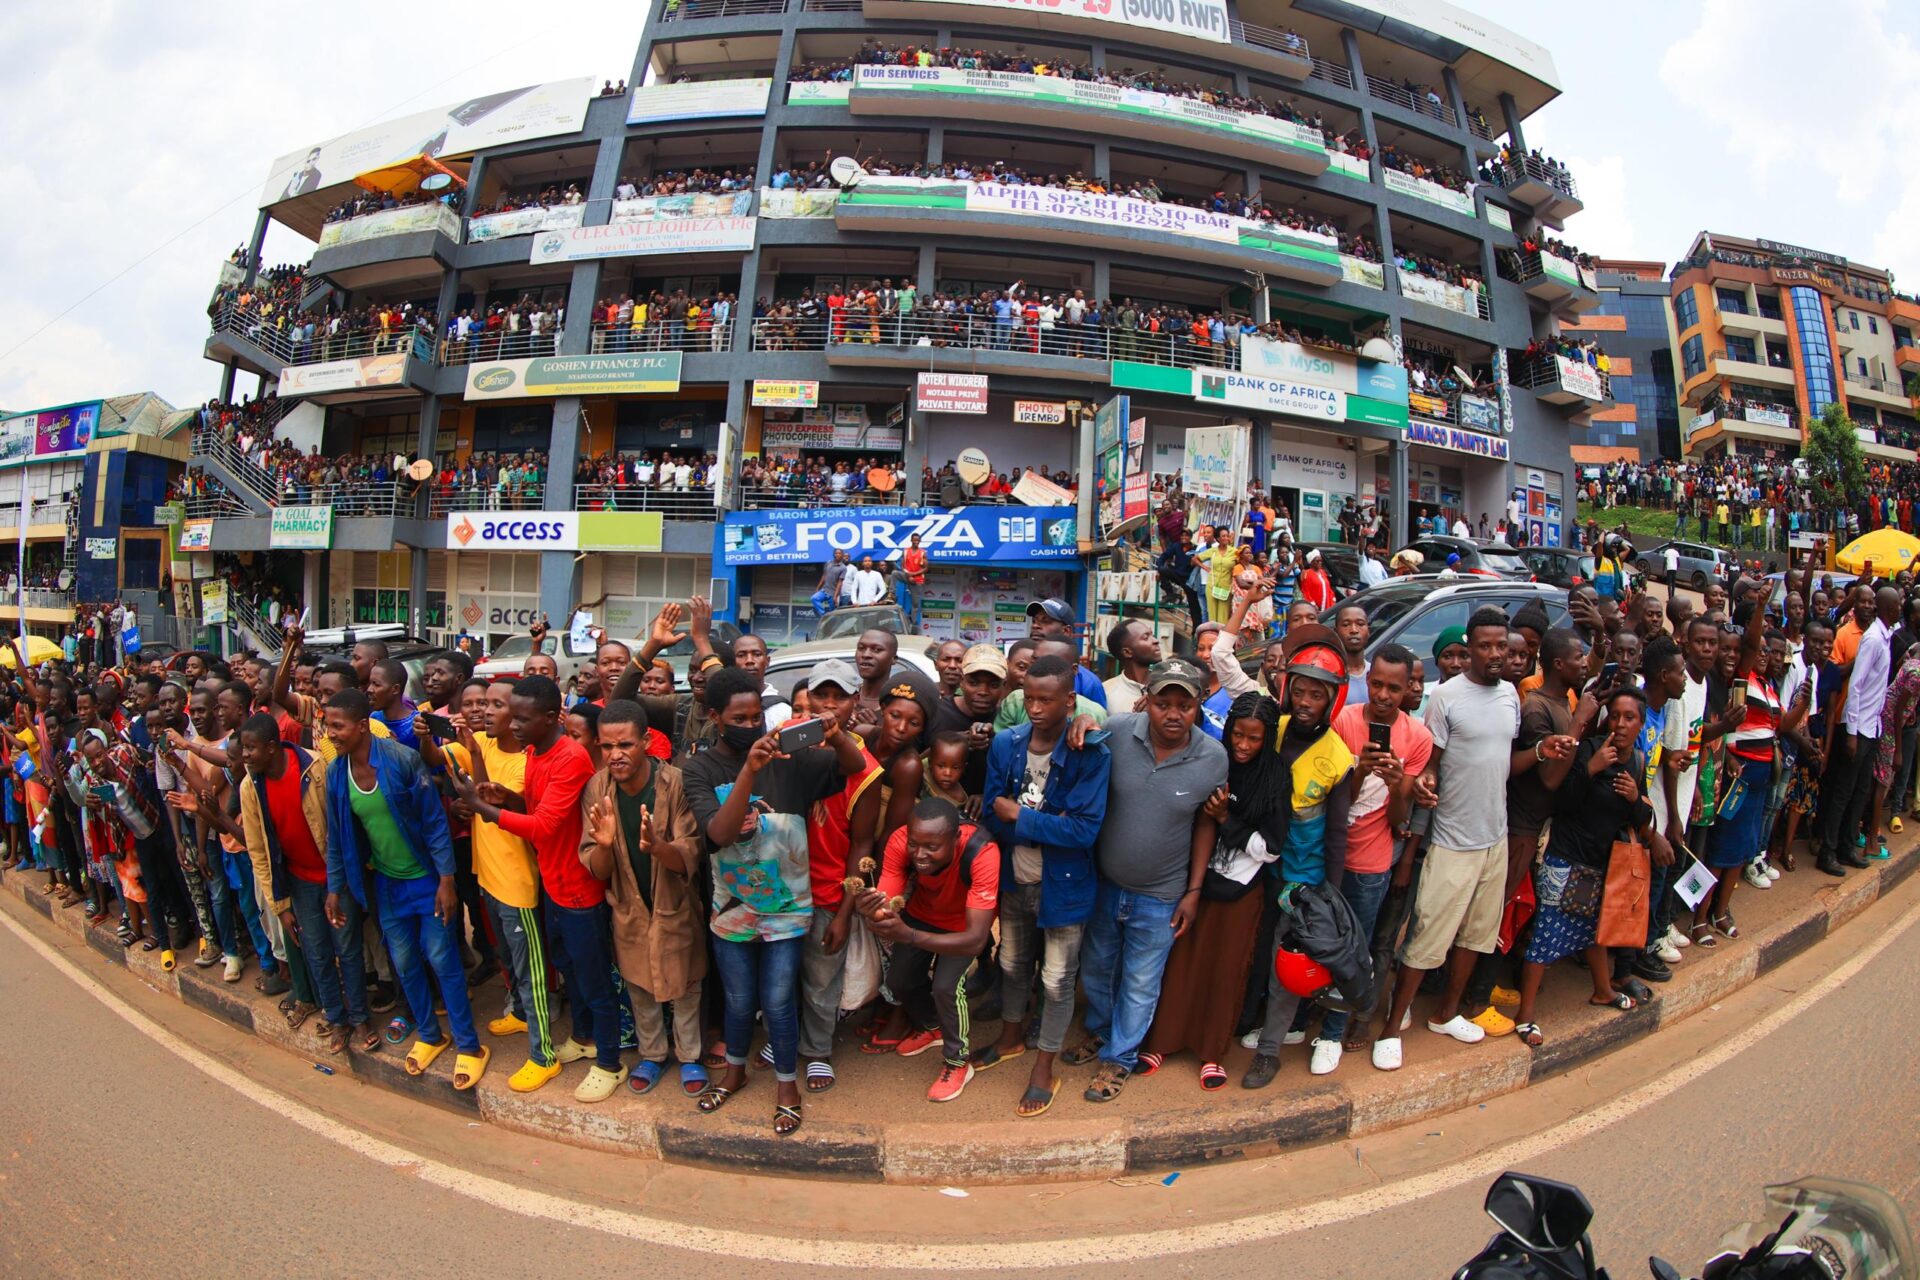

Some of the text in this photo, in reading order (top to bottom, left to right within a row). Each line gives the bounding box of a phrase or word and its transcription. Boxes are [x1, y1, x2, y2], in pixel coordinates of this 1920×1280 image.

[863, 68, 940, 80] OUR SERVICES
[966, 78, 1010, 88] PEDIATRICS
[1075, 82, 1120, 94] GYNECOLOGY
[974, 185, 1230, 229] ALPHA SPORT RESTO-BAR
[572, 224, 642, 241] CLECAM
[646, 219, 725, 237] EJOHEZA
[1775, 243, 1829, 261] KAIZEN HOTEL
[1775, 269, 1809, 280] KAIZEN
[1427, 340, 1455, 357] SALON
[543, 357, 667, 372] GOSHEN FINANCE PLC
[1289, 355, 1335, 375] MySol
[568, 371, 635, 380] NYABUGOGO BRANCH
[918, 374, 988, 389] NOTERI WIKORERA
[926, 388, 980, 399] NOTAIRE PRIVÉ
[1228, 375, 1337, 402] BANK OF AFRICA
[917, 399, 988, 411] PRIVATE NOTARY
[1018, 402, 1053, 412] PHOTO
[1268, 397, 1319, 410] BMCE GROUP
[1020, 412, 1060, 423] IREMBO
[765, 423, 834, 433] PHOTO EXPRESS
[763, 432, 833, 441] PHOTOCOPIEUSE
[1407, 422, 1449, 447] AMACO
[1450, 430, 1489, 455] PAINTS
[1276, 453, 1347, 470] BANK OF AFRICA
[285, 508, 313, 520] GOAL
[769, 507, 935, 520] BARON SPORTS GAMING LTD
[272, 520, 328, 532] PHARMACY
[482, 520, 564, 541] access
[766, 552, 810, 560] BETTING
[379, 592, 408, 606] GOA
[359, 606, 440, 625] PHARMY
